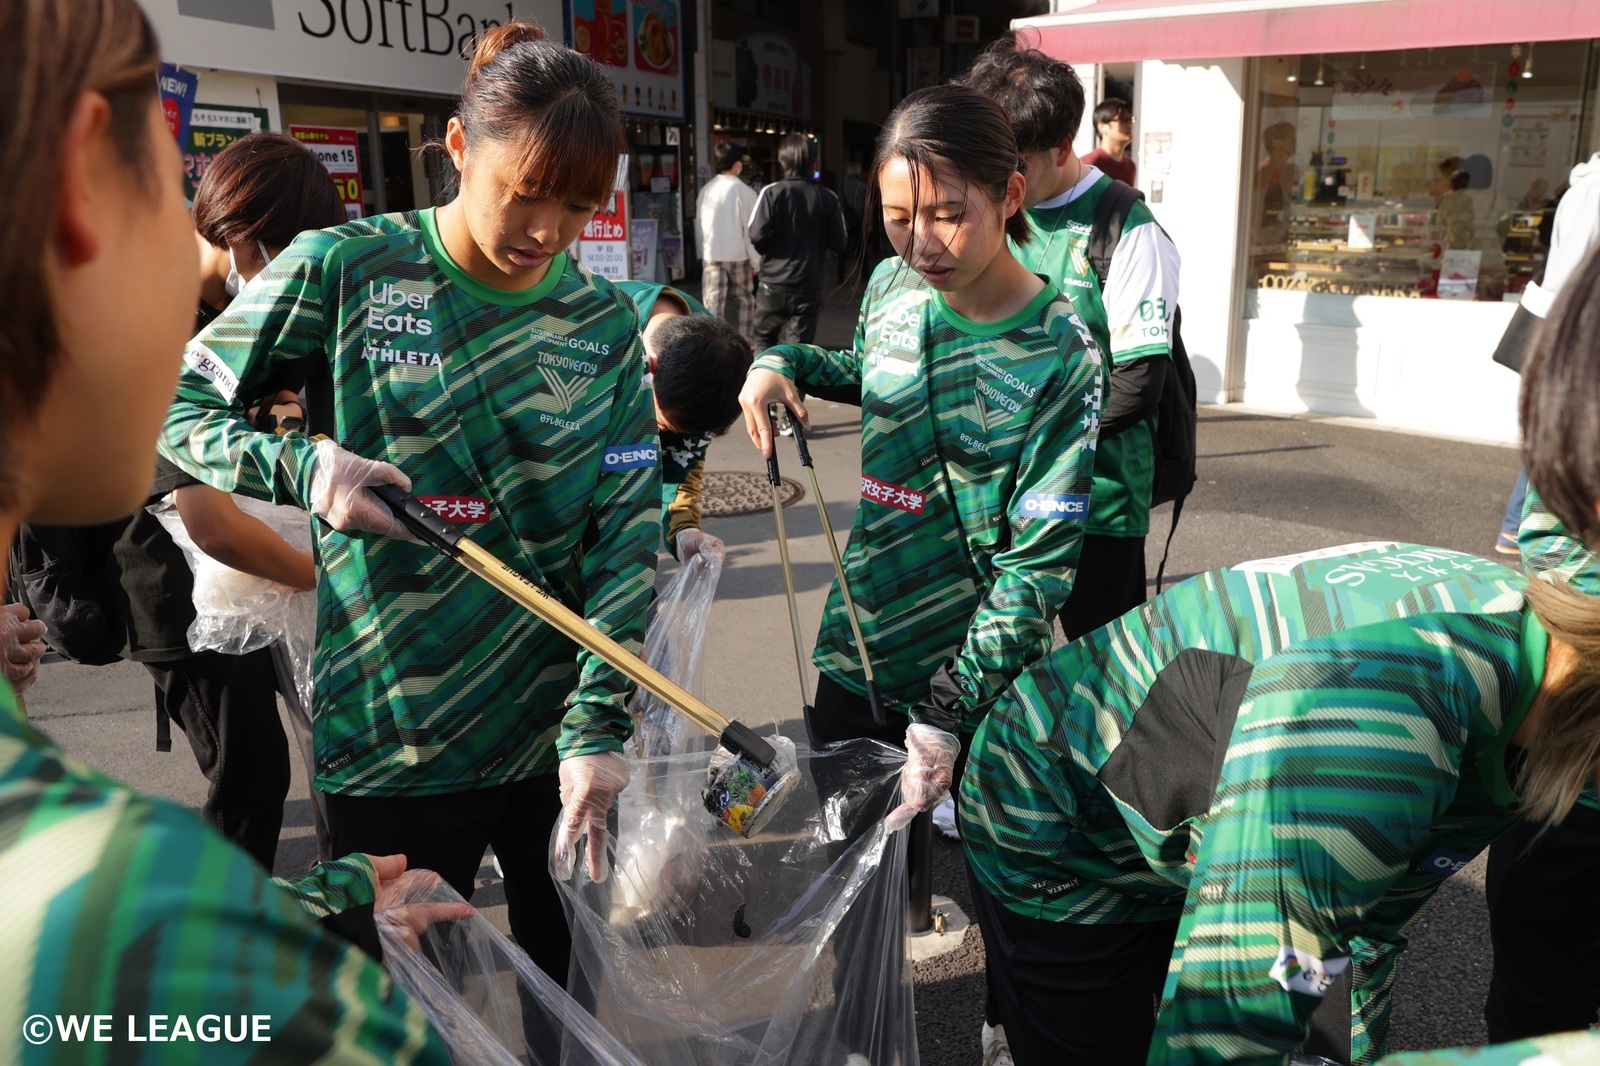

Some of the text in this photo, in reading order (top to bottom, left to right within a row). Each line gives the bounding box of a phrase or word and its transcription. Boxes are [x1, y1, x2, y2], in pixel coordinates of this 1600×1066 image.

[341, 150, 354, 162] 15
[369, 280, 433, 310] Uber
[367, 306, 432, 336] Eats
[361, 346, 442, 367] ATHLETA
[568, 338, 610, 356] GOALS
[1004, 373, 1036, 398] GOALS
[420, 500, 486, 518] 子大学
